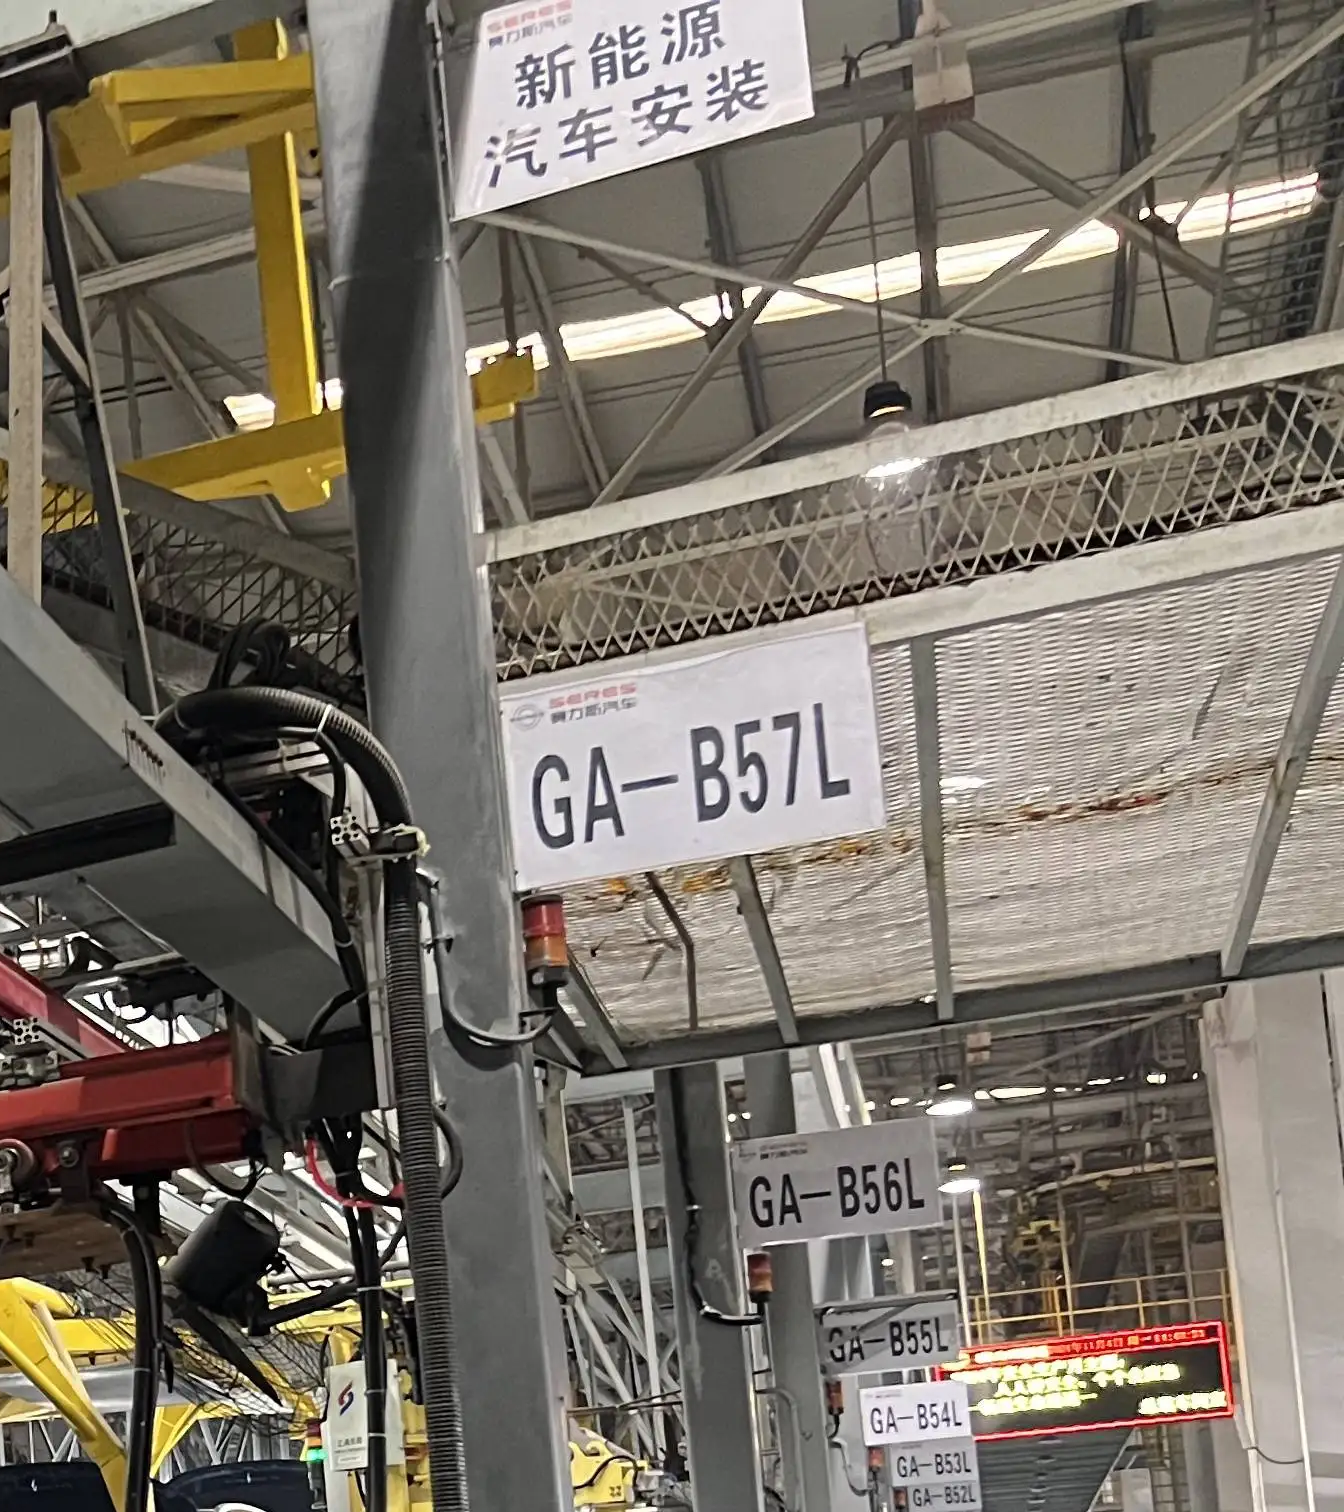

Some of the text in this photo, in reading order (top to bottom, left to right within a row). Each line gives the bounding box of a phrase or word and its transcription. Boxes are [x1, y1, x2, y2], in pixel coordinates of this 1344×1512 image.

[514, 2, 726, 110] 新能源
[484, 58, 768, 188] 汽车安装
